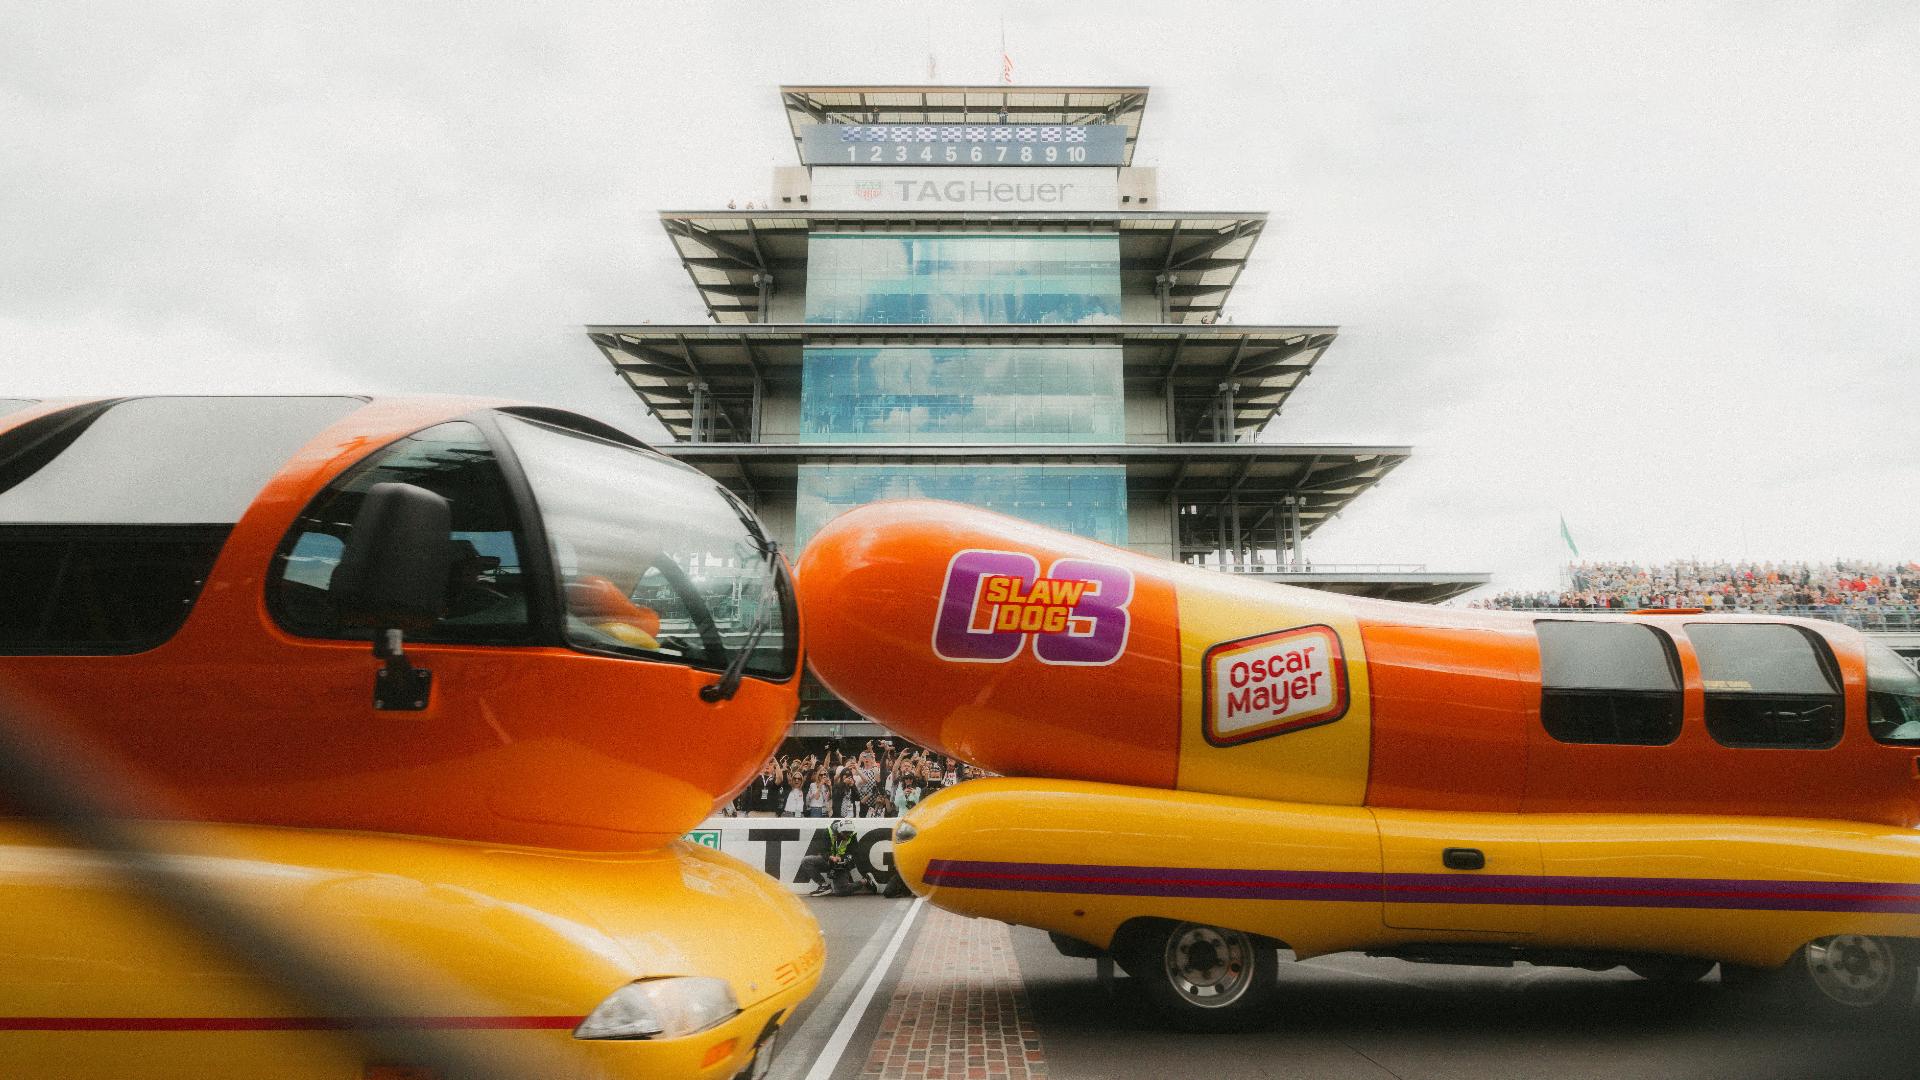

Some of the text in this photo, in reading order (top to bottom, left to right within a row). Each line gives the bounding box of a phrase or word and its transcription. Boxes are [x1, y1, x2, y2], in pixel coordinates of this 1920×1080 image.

[847, 145, 1086, 162] 1 2 3 4 5 6 7 8 9 10
[986, 577, 1085, 606] SLAW
[995, 604, 1069, 633] DOG
[1230, 646, 1315, 688] Oscar
[1227, 671, 1323, 718] Mayer
